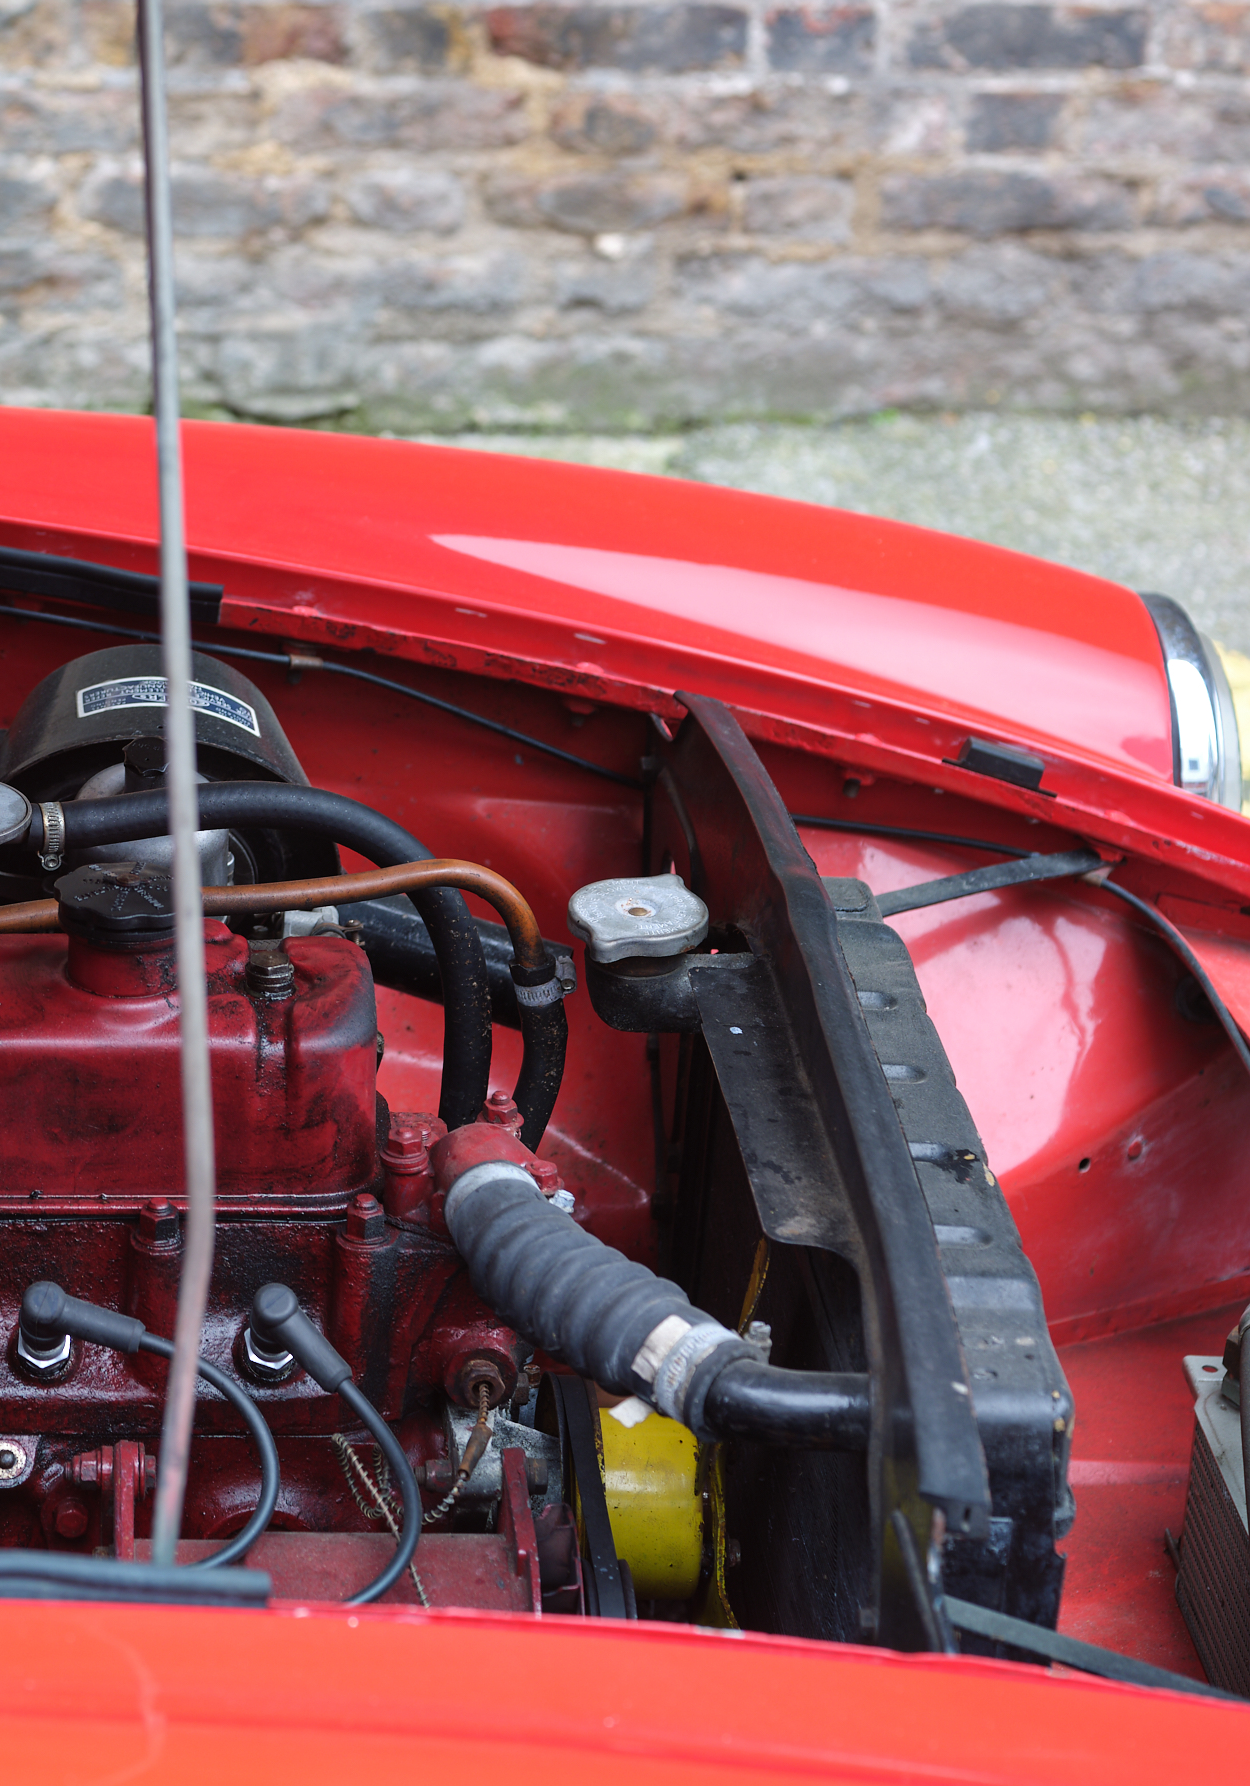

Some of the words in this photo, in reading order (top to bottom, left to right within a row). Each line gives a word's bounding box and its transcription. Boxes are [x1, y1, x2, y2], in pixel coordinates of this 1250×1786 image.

[119, 687, 164, 695] ELEMENT
[84, 692, 112, 703] REFER
[140, 694, 208, 706] COERS
[196, 694, 231, 710] SERVICE
